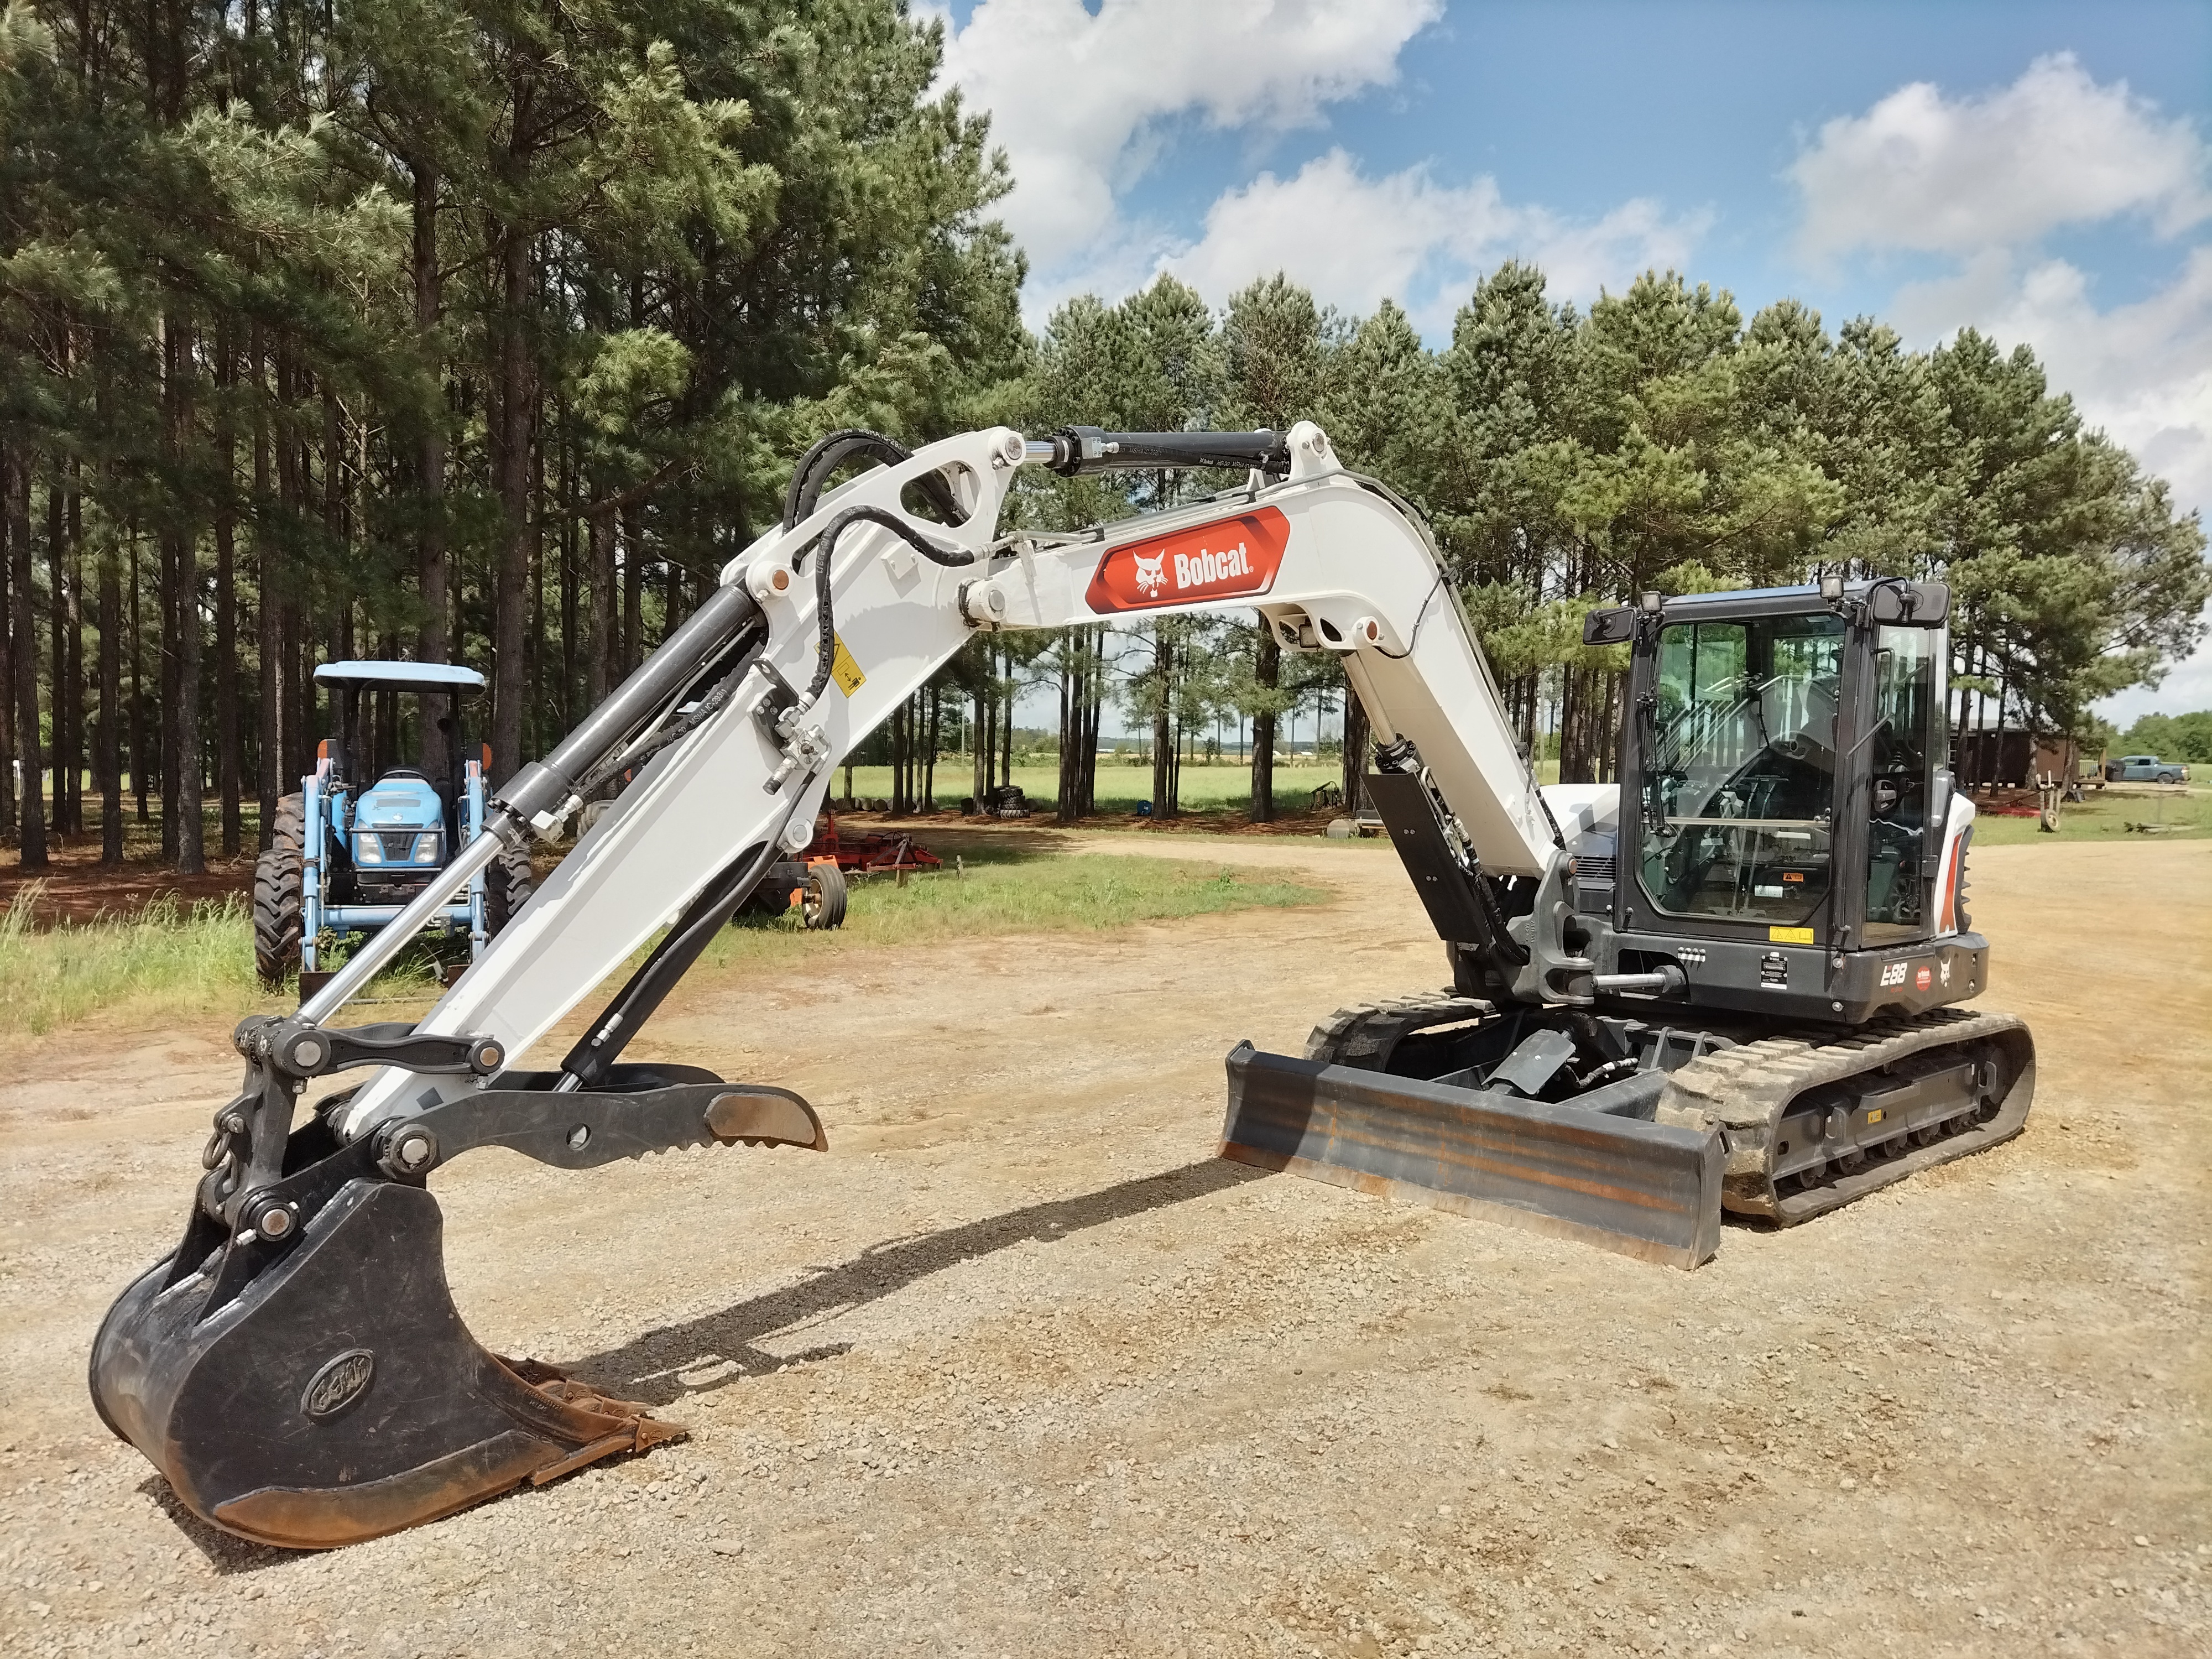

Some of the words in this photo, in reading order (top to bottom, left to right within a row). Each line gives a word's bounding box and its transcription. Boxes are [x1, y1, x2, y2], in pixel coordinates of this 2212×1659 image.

[858, 428, 880, 437] MSHA
[1174, 542, 1249, 589] Bobcat
[688, 708, 708, 727] MSHA
[1880, 962, 1908, 987] E88
